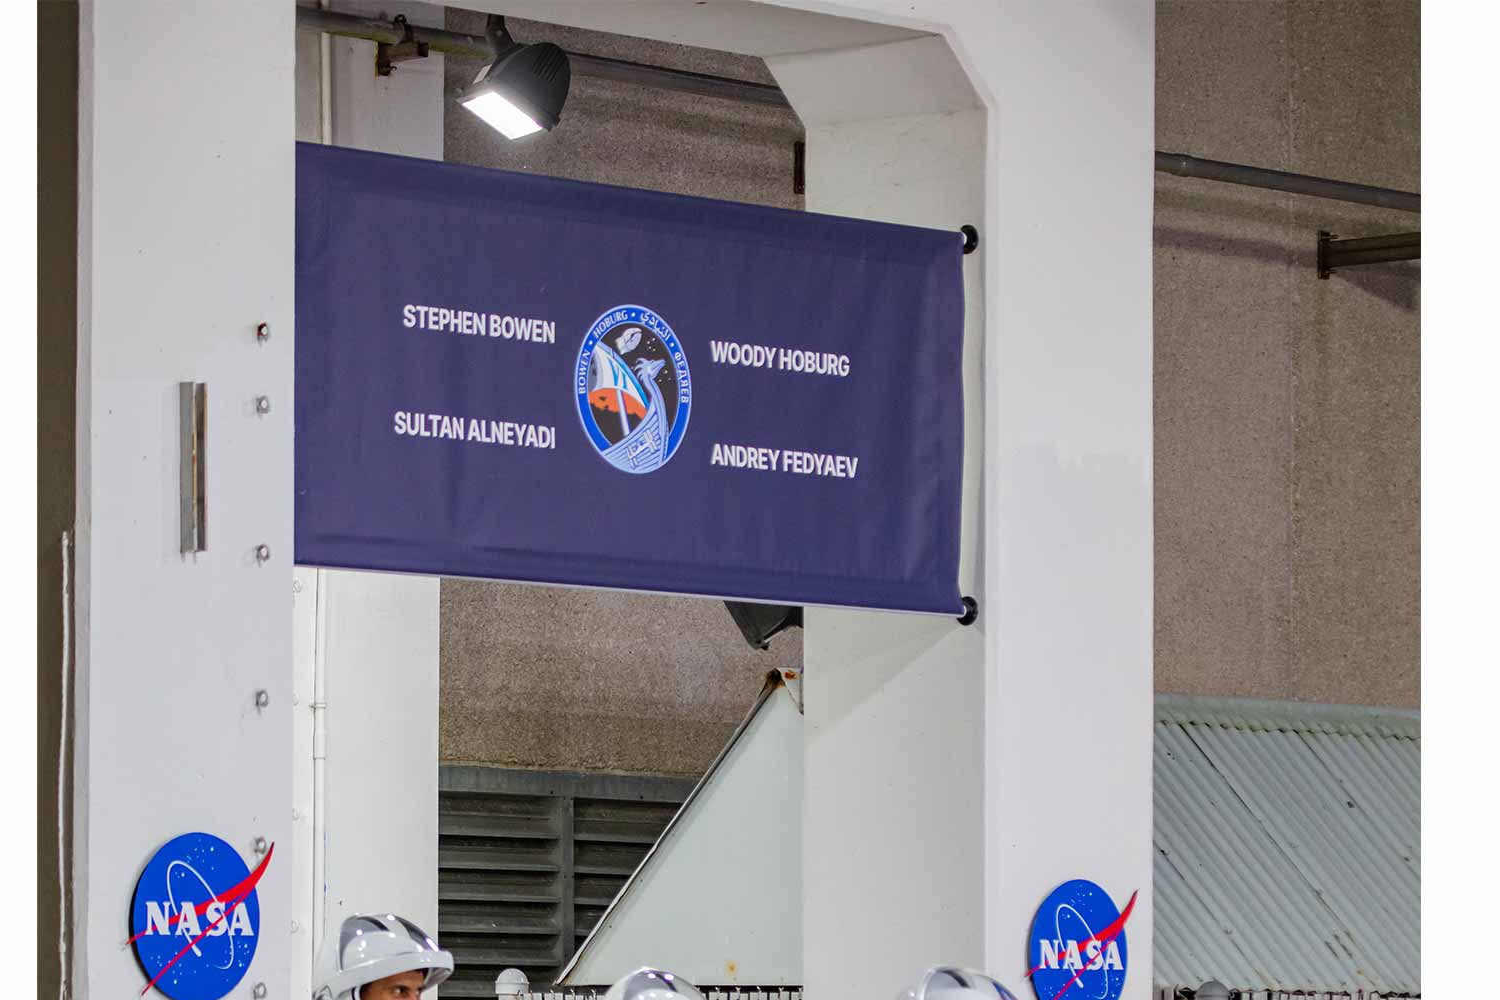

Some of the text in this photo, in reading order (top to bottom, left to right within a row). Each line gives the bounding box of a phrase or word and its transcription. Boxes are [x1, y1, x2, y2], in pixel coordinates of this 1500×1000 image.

[402, 304, 556, 344] STEPHEN BOWEN
[592, 310, 628, 339] HOBURG
[578, 351, 591, 394] BOWEN
[710, 340, 851, 377] WOODY HOBURG
[674, 351, 689, 404] ФЕДЯЕВ
[394, 411, 556, 449] SULTAN ALNEYADI
[711, 443, 858, 478] ANDREY FEDYAEV
[145, 901, 255, 936] NASA
[1039, 939, 1124, 970] NASA
